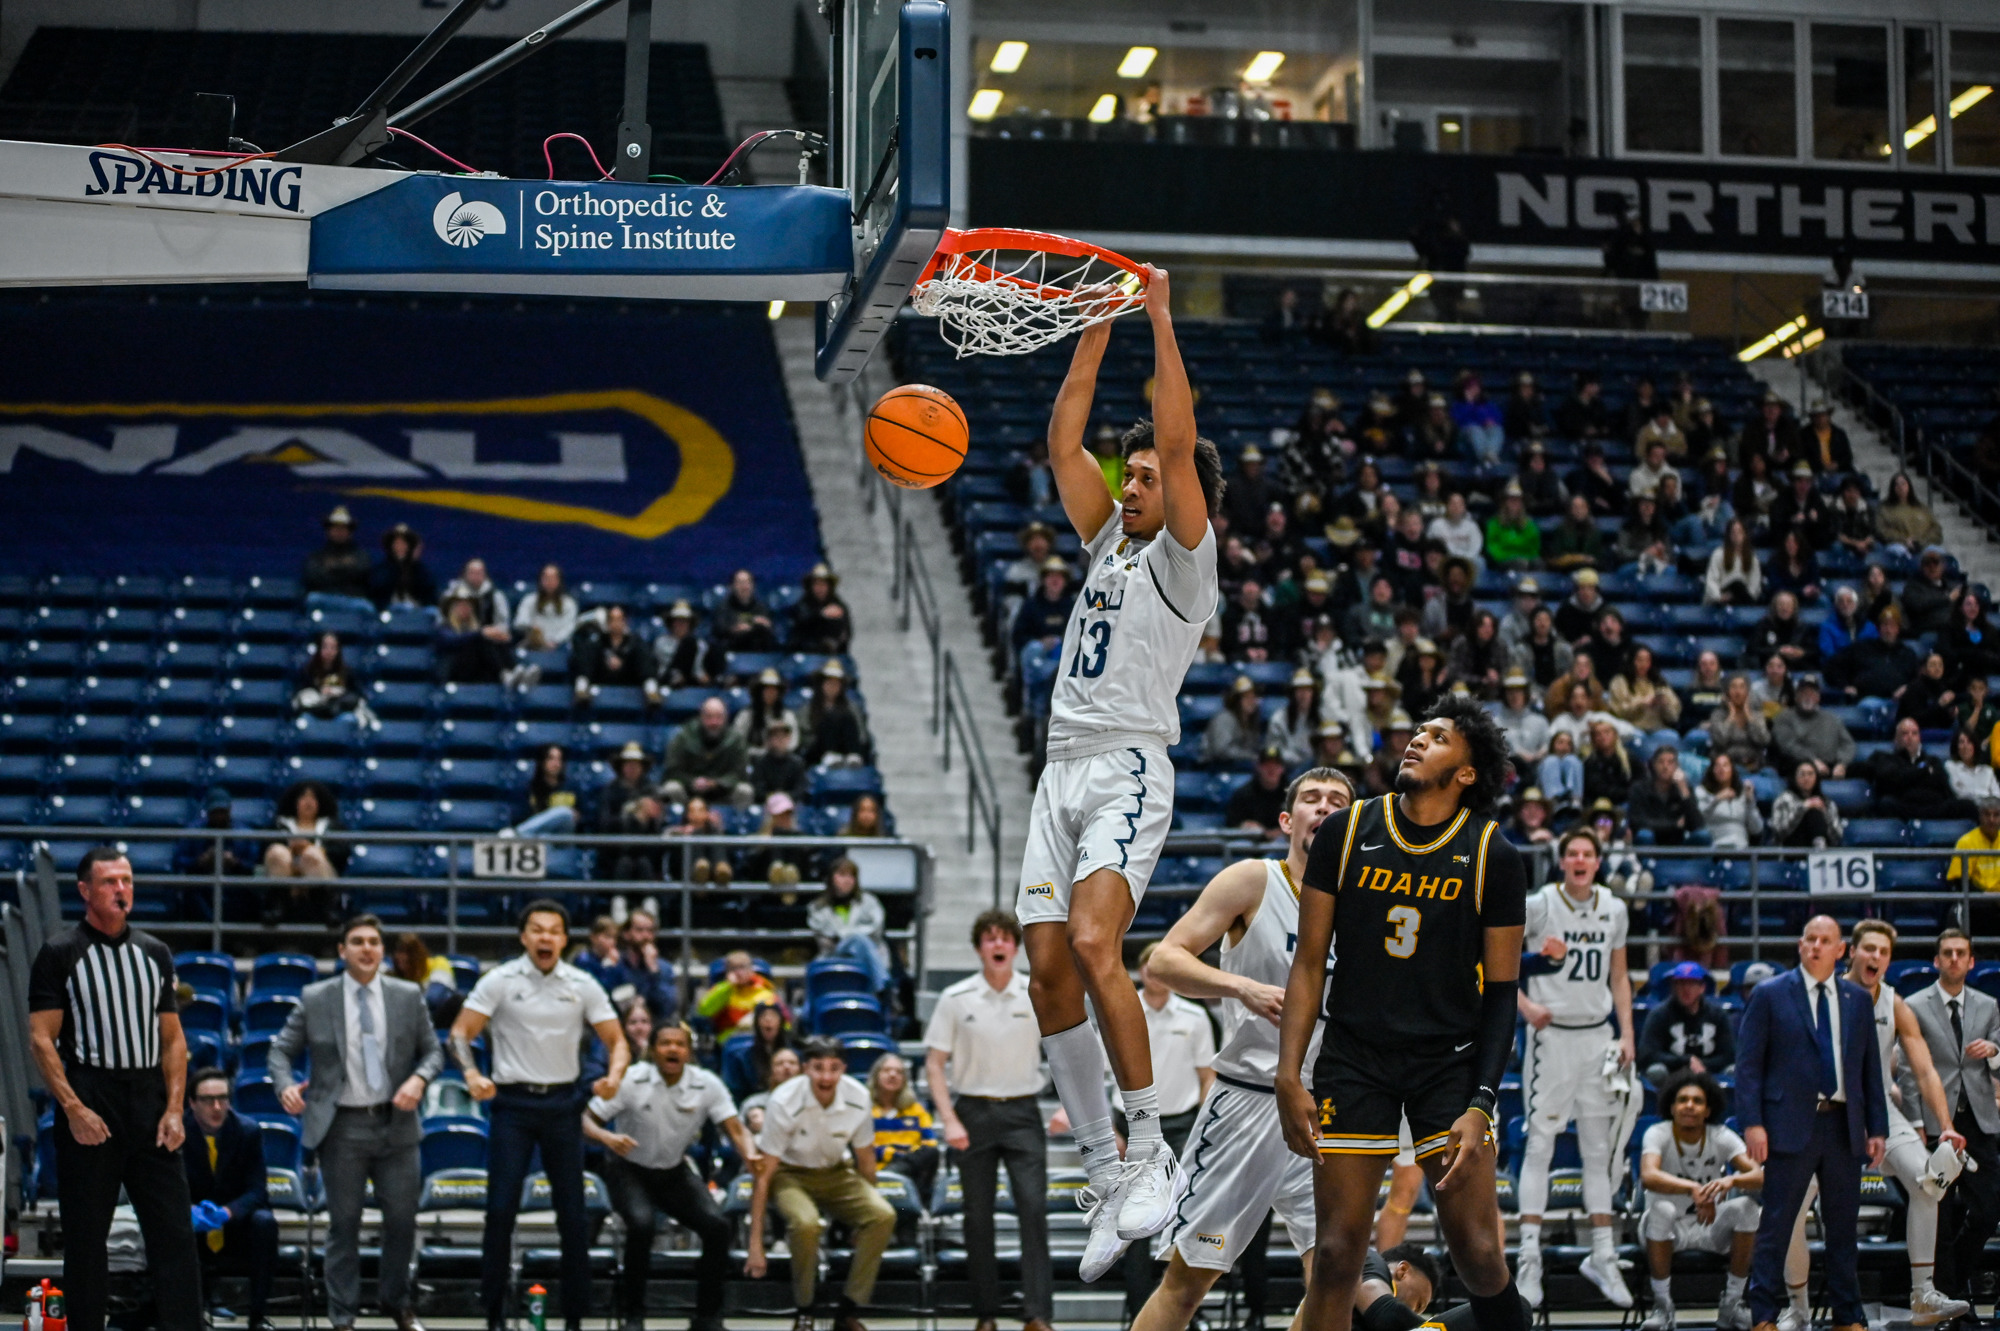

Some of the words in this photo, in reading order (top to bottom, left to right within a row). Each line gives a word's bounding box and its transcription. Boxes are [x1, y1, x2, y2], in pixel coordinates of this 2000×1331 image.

[85, 151, 303, 213] SPALDING
[535, 190, 692, 223] Orthopedic
[701, 193, 728, 218] &
[1496, 173, 2000, 245] NORTHER
[535, 223, 613, 257] Spine
[621, 224, 736, 250] Institute
[1644, 286, 1684, 308] 216
[1826, 294, 1864, 315] 214
[1068, 617, 1111, 678] 13
[482, 845, 540, 873] 118
[1813, 857, 1869, 888] 116
[1027, 886, 1051, 896] NAU
[1357, 866, 1463, 901] IDAHO
[1384, 904, 1422, 959] 3
[1564, 931, 1604, 943] NAU
[1567, 948, 1602, 982] 20
[1199, 1236, 1221, 1245] NAU
